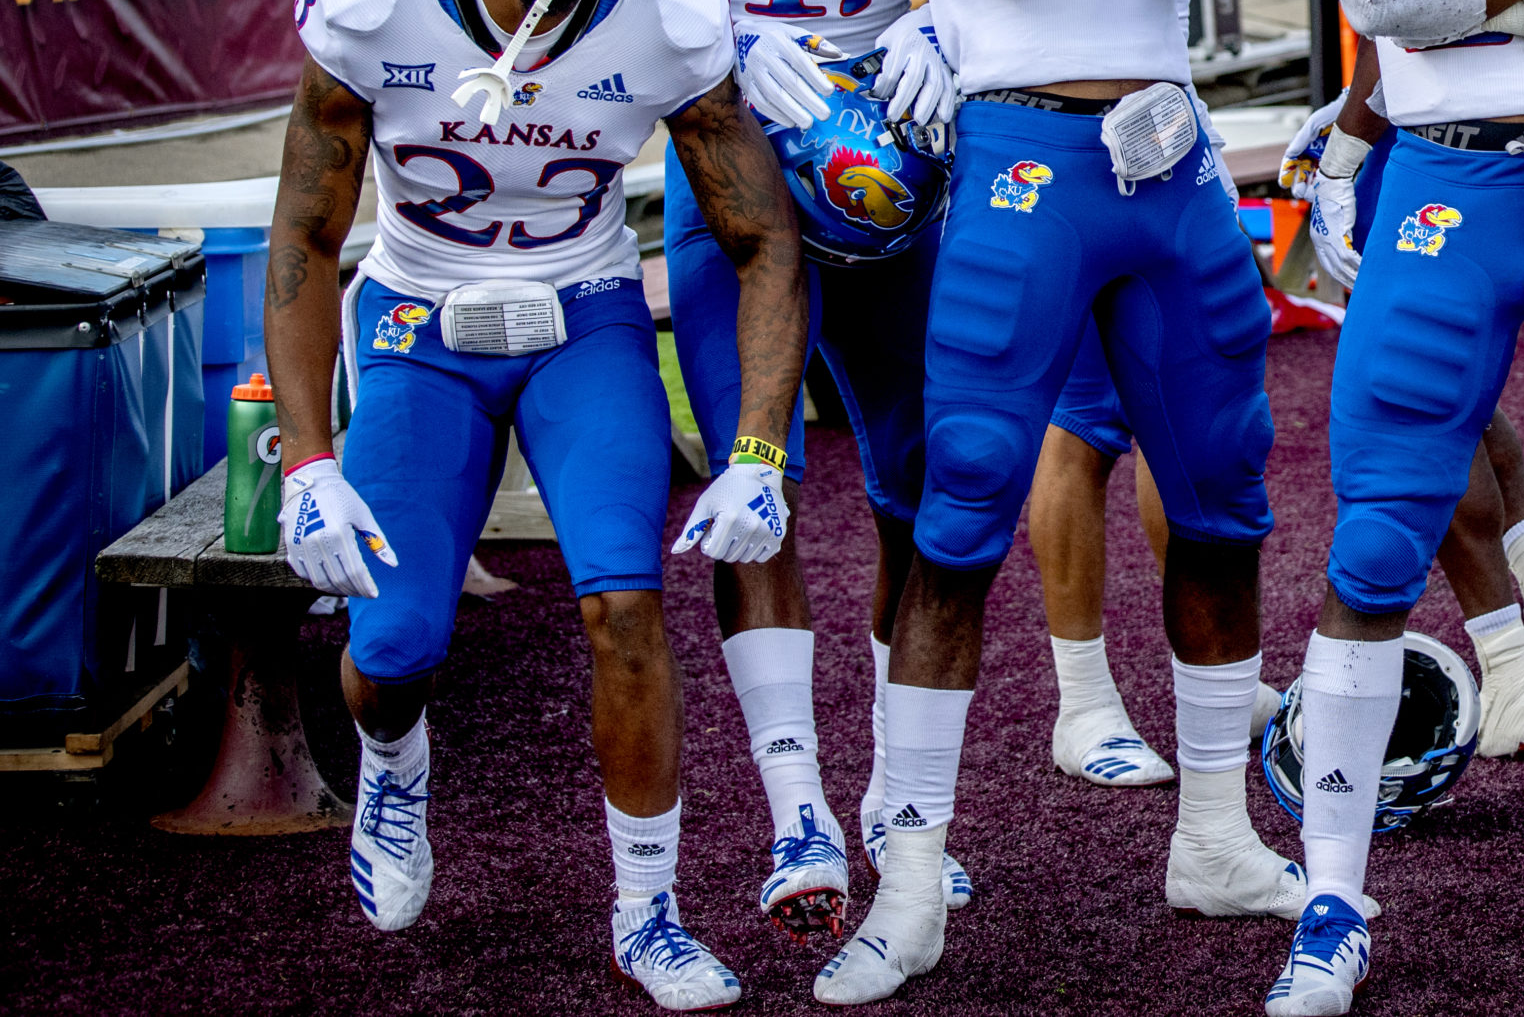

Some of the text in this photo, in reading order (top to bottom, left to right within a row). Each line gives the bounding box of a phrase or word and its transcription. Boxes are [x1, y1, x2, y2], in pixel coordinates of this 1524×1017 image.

[383, 65, 434, 90] XII
[577, 90, 635, 104] adidas
[835, 108, 878, 141] KU
[439, 121, 602, 153] KANSAS
[393, 144, 625, 250] 23
[1414, 228, 1429, 240] KU
[574, 279, 620, 300] adidas
[387, 327, 400, 337] KU
[752, 440, 777, 464] THE
[291, 492, 311, 546] adidas
[762, 485, 783, 537] adidas
[766, 744, 804, 755] adidas
[1316, 781, 1353, 793] adidas
[891, 817, 927, 828] adidas
[627, 845, 667, 858] adidas
